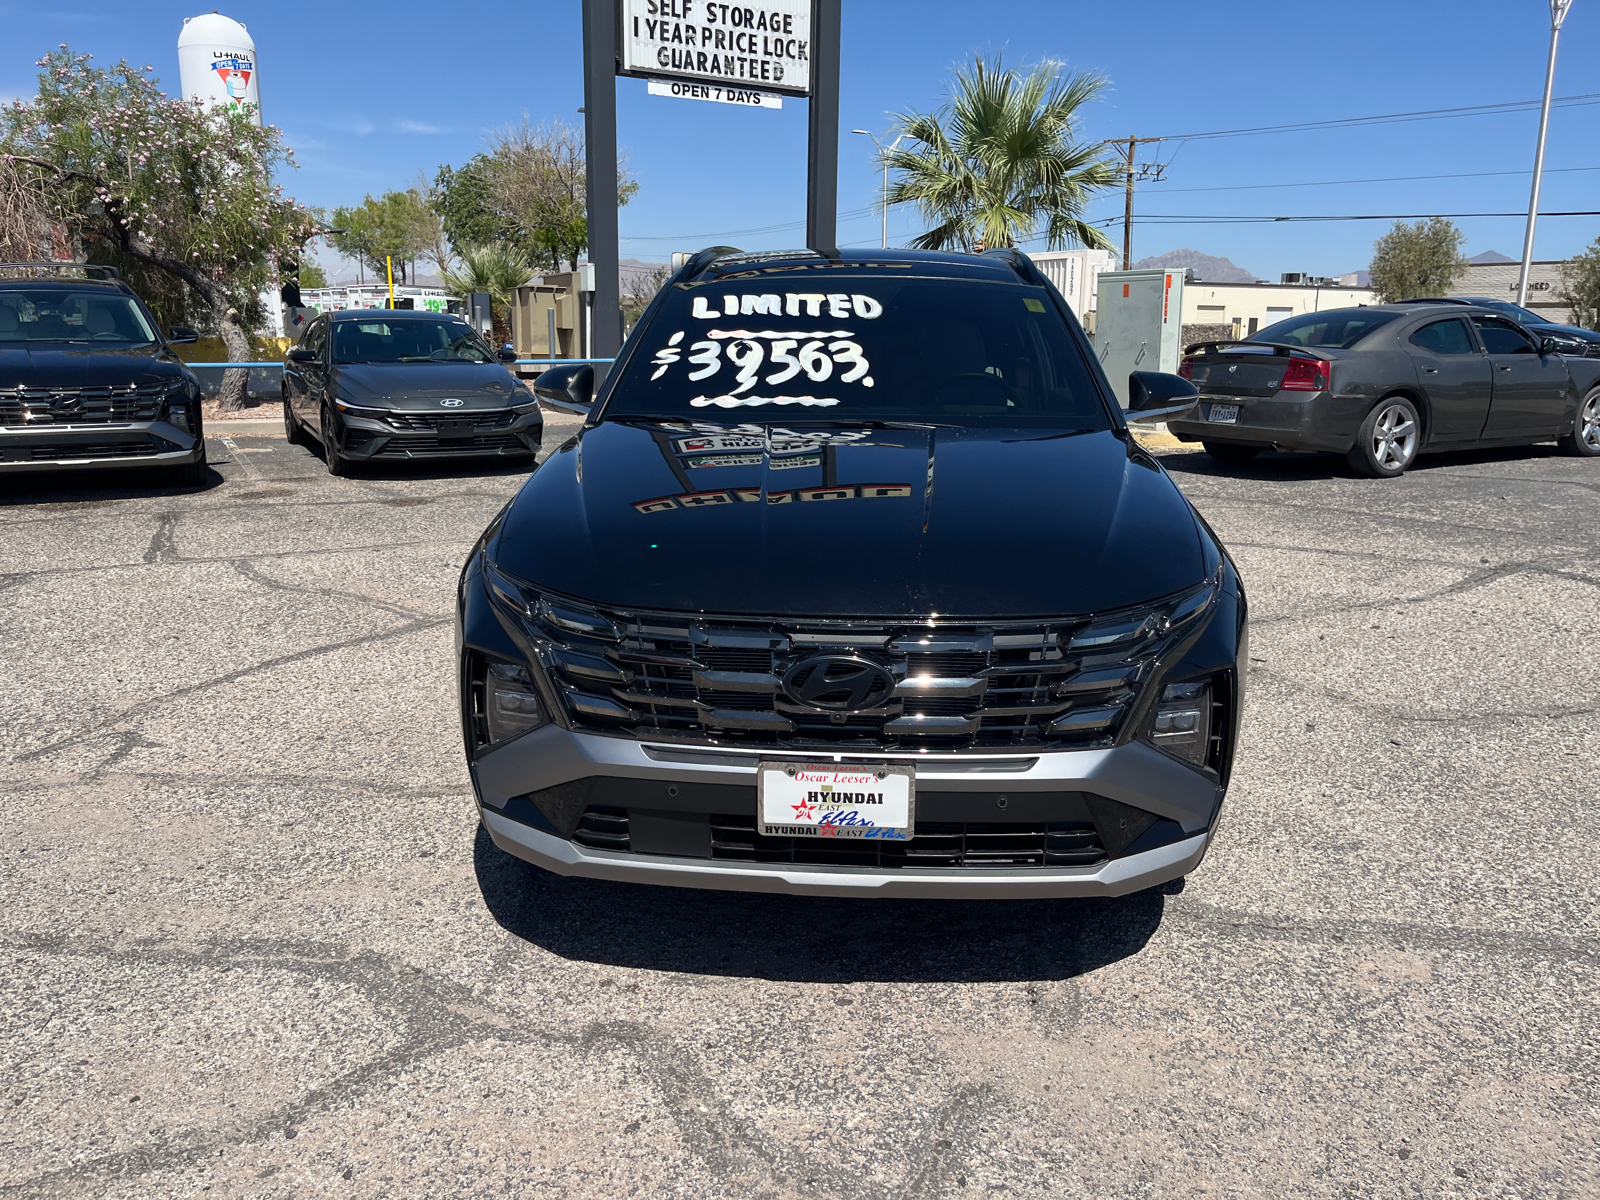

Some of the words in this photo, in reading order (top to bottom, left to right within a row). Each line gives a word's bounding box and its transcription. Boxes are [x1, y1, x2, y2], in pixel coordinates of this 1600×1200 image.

[647, 0, 692, 19] SELF
[706, 2, 793, 34] STORAGE
[645, 18, 697, 46] YEAR
[702, 27, 758, 54] PRICE
[763, 36, 808, 60] LOCK
[213, 51, 251, 62] U-HAUL
[657, 46, 785, 81] GUARANTEED
[216, 60, 232, 69] OPEN
[670, 83, 710, 99] OPEN
[716, 87, 722, 100] 7
[726, 90, 761, 105] DAYS
[1510, 282, 1550, 290] LOHEED
[692, 293, 883, 319] LIMITED
[806, 763, 831, 771] Oscar
[834, 764, 867, 772] Leeser's
[794, 771, 829, 783] Oscar
[833, 773, 879, 784] Leeser's
[807, 791, 884, 804] HYUNDAI
[818, 811, 841, 826] El
[840, 811, 875, 827] Paso
[765, 825, 818, 836] HYUNDAI
[864, 828, 879, 838] El
[882, 828, 906, 839] Paso
